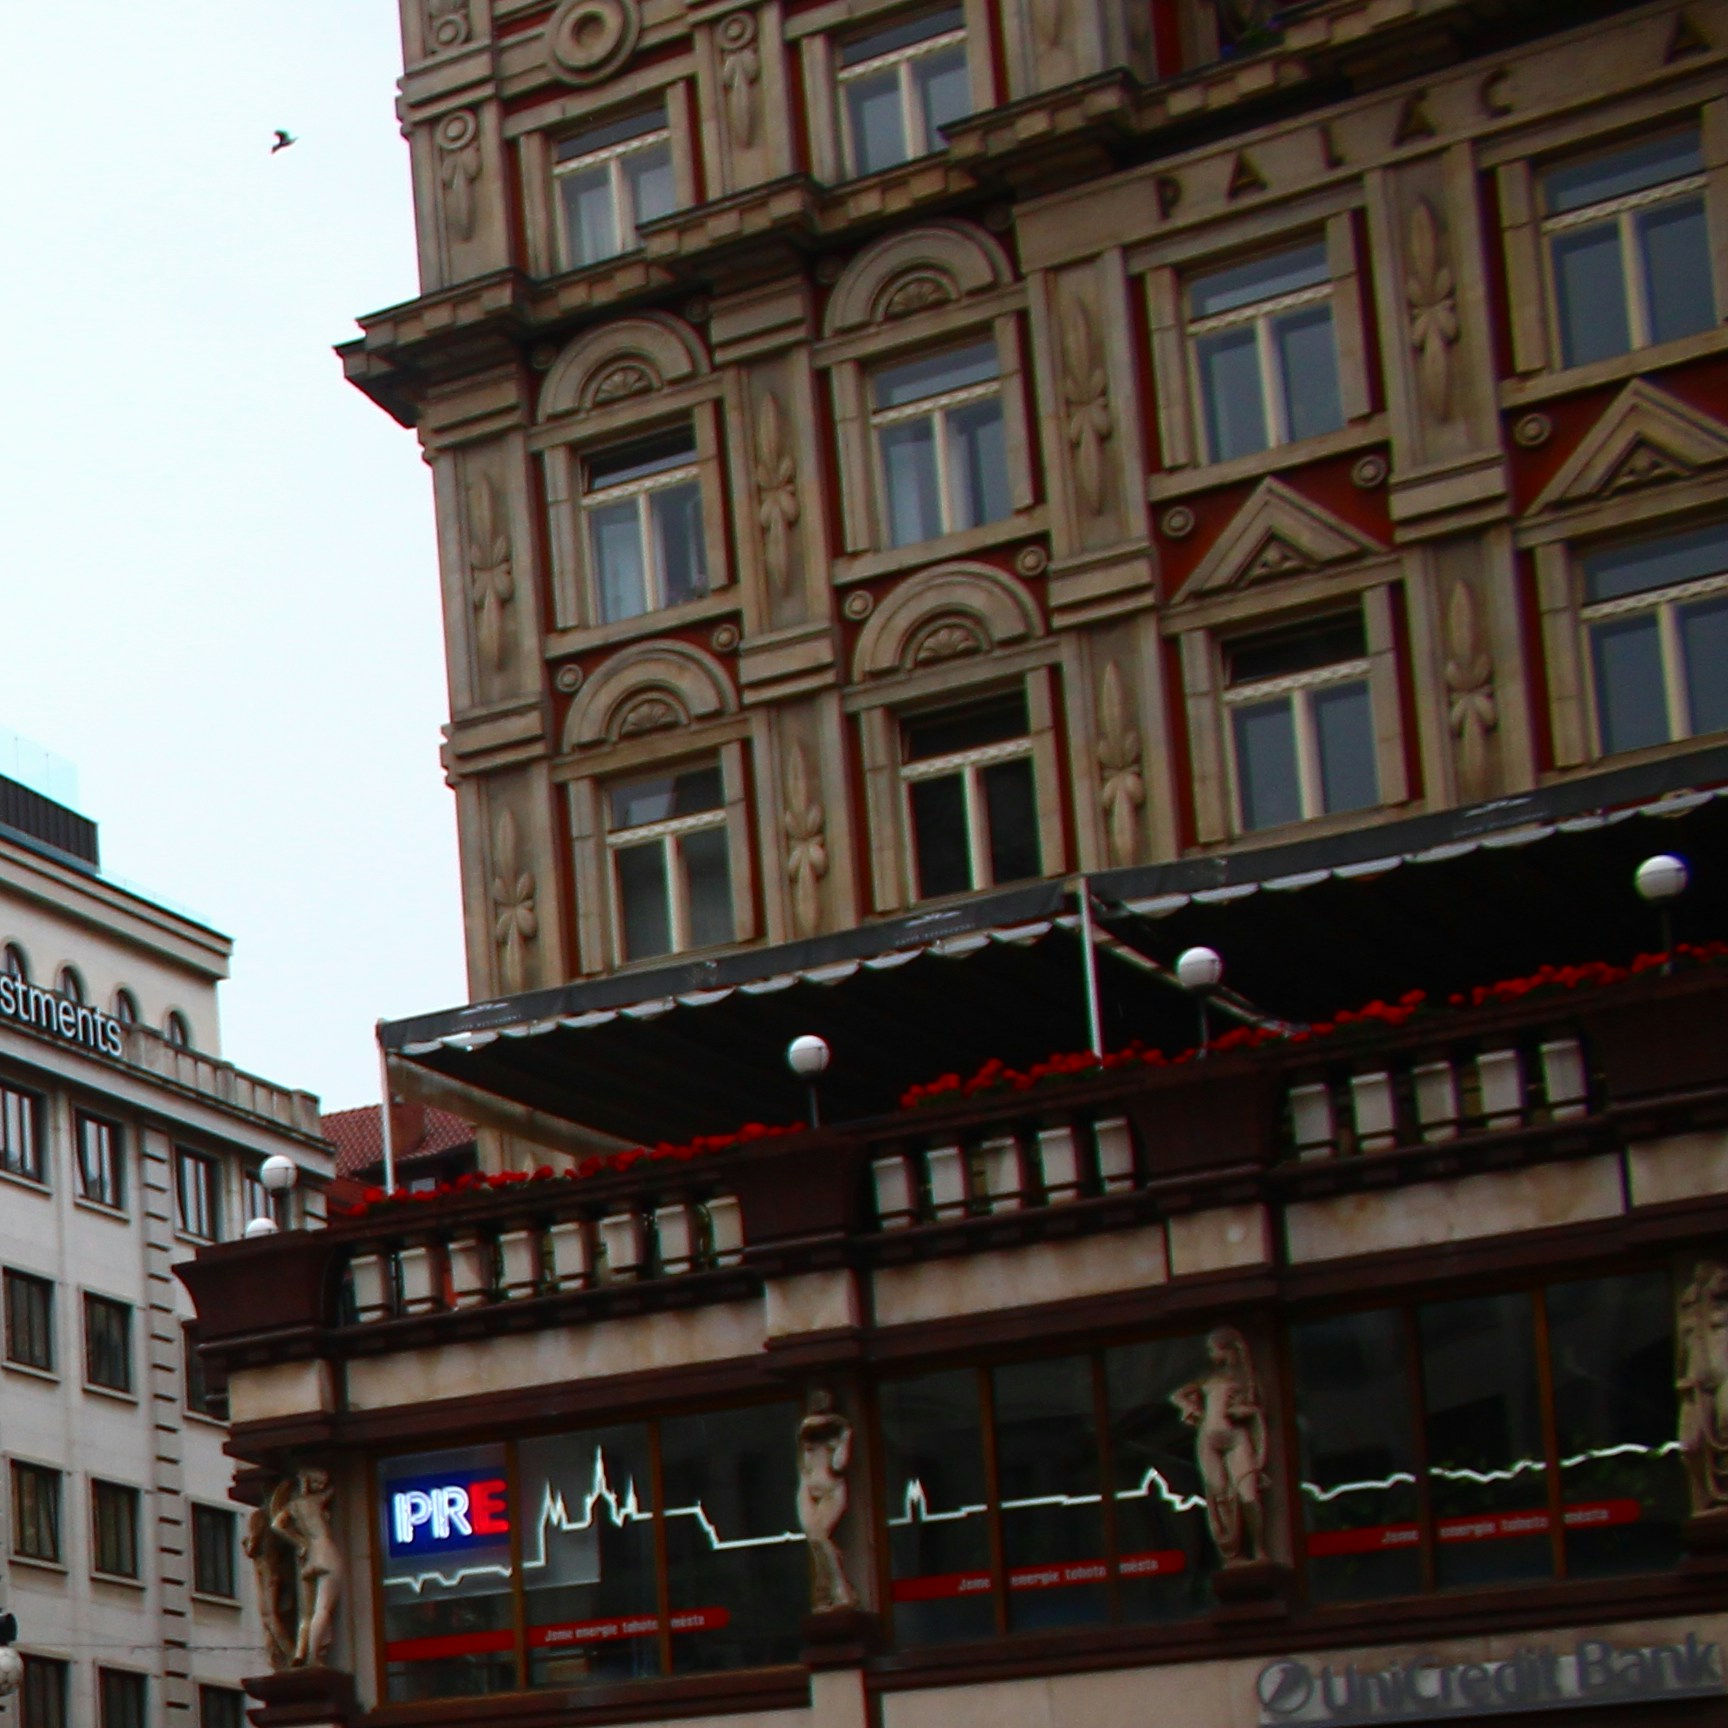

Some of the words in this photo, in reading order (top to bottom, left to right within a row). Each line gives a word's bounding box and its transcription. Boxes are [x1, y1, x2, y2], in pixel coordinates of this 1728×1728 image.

[394, 1479, 510, 1543] PRE
[1320, 1643, 1563, 1716] UniCredit
[1575, 1631, 1722, 1692] Bank
